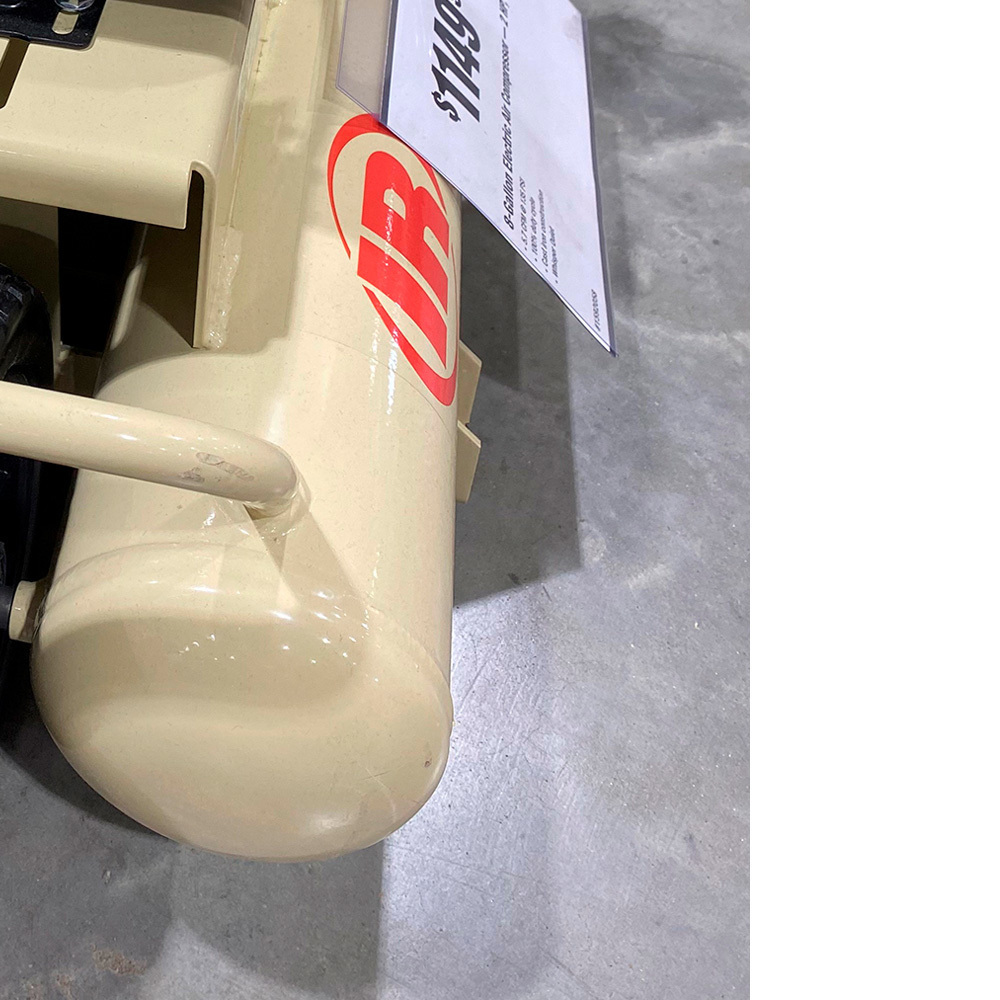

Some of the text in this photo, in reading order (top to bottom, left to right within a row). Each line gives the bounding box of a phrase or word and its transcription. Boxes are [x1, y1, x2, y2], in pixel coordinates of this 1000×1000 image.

[501, 39, 512, 107] Compressor
[501, 104, 511, 127] Air
[502, 124, 513, 173] Electric
[503, 172, 514, 231] 8-Gallon
[550, 244, 558, 278] Whisper
